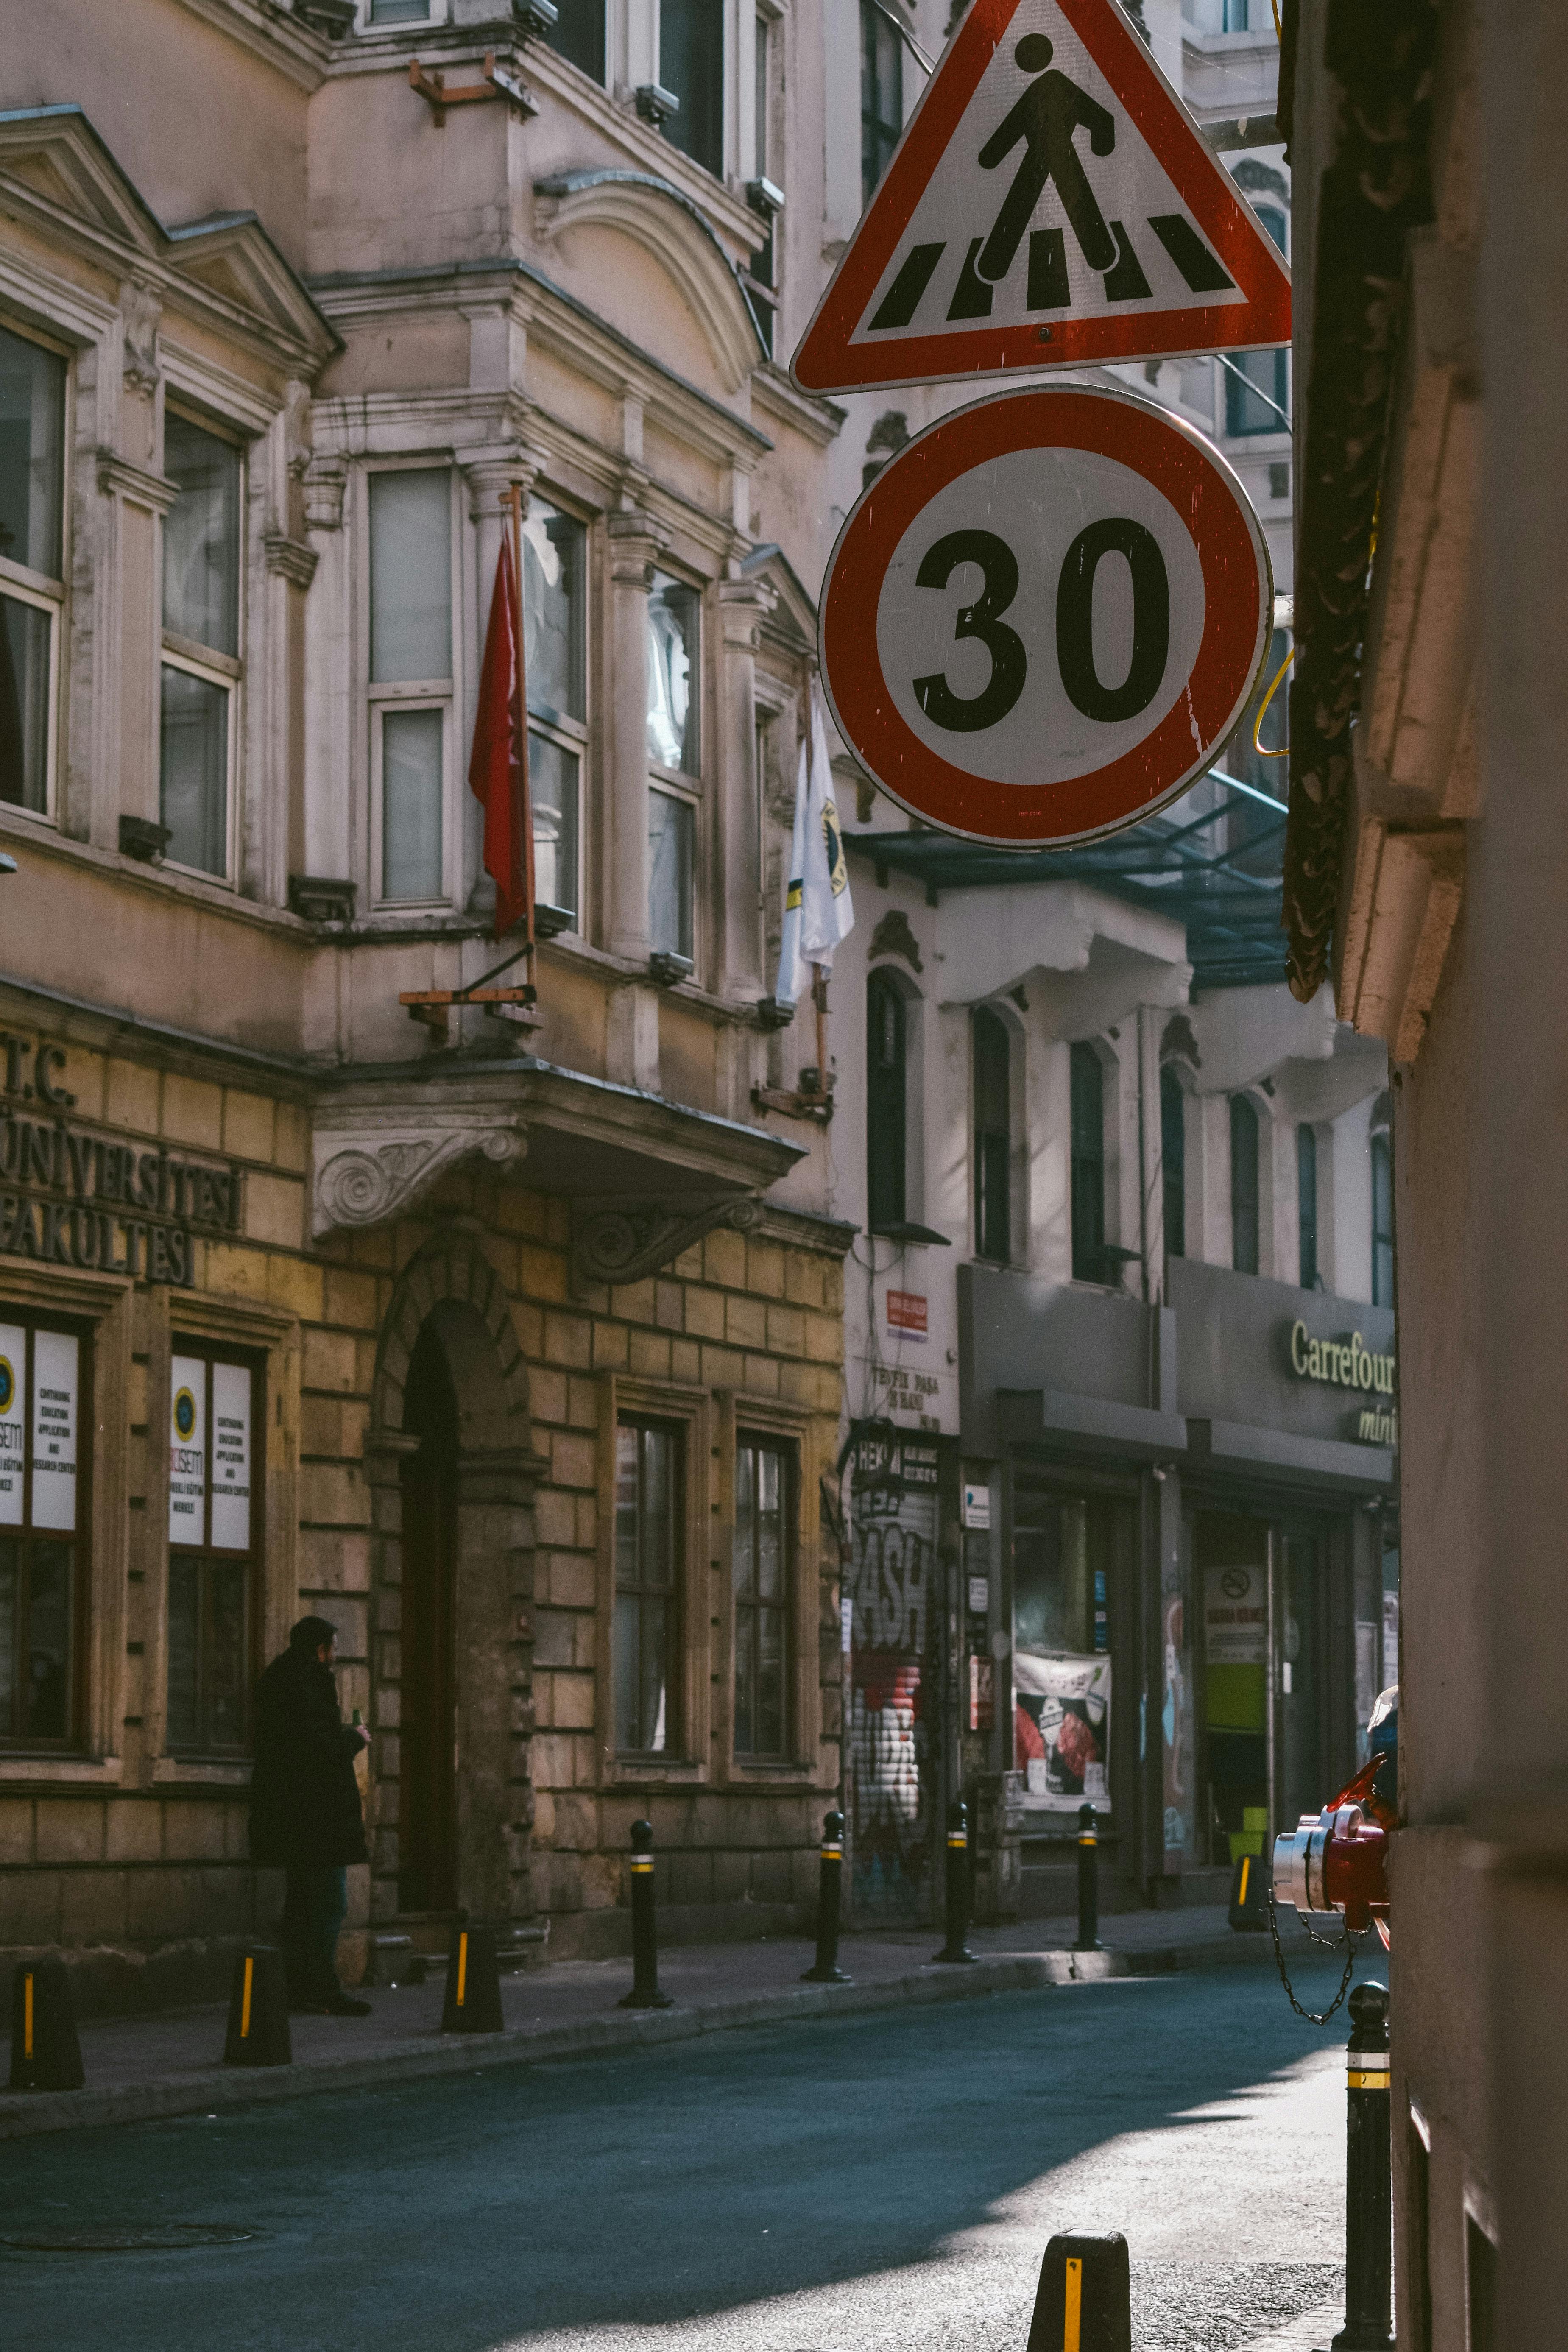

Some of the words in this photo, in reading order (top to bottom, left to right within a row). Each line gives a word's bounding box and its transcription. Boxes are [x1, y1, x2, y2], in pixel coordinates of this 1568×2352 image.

[912, 517, 1169, 733] 30
[0, 1032, 78, 1107] T.C.
[1292, 1320, 1395, 1394] Carrefour
[1359, 1404, 1396, 1445] mini
